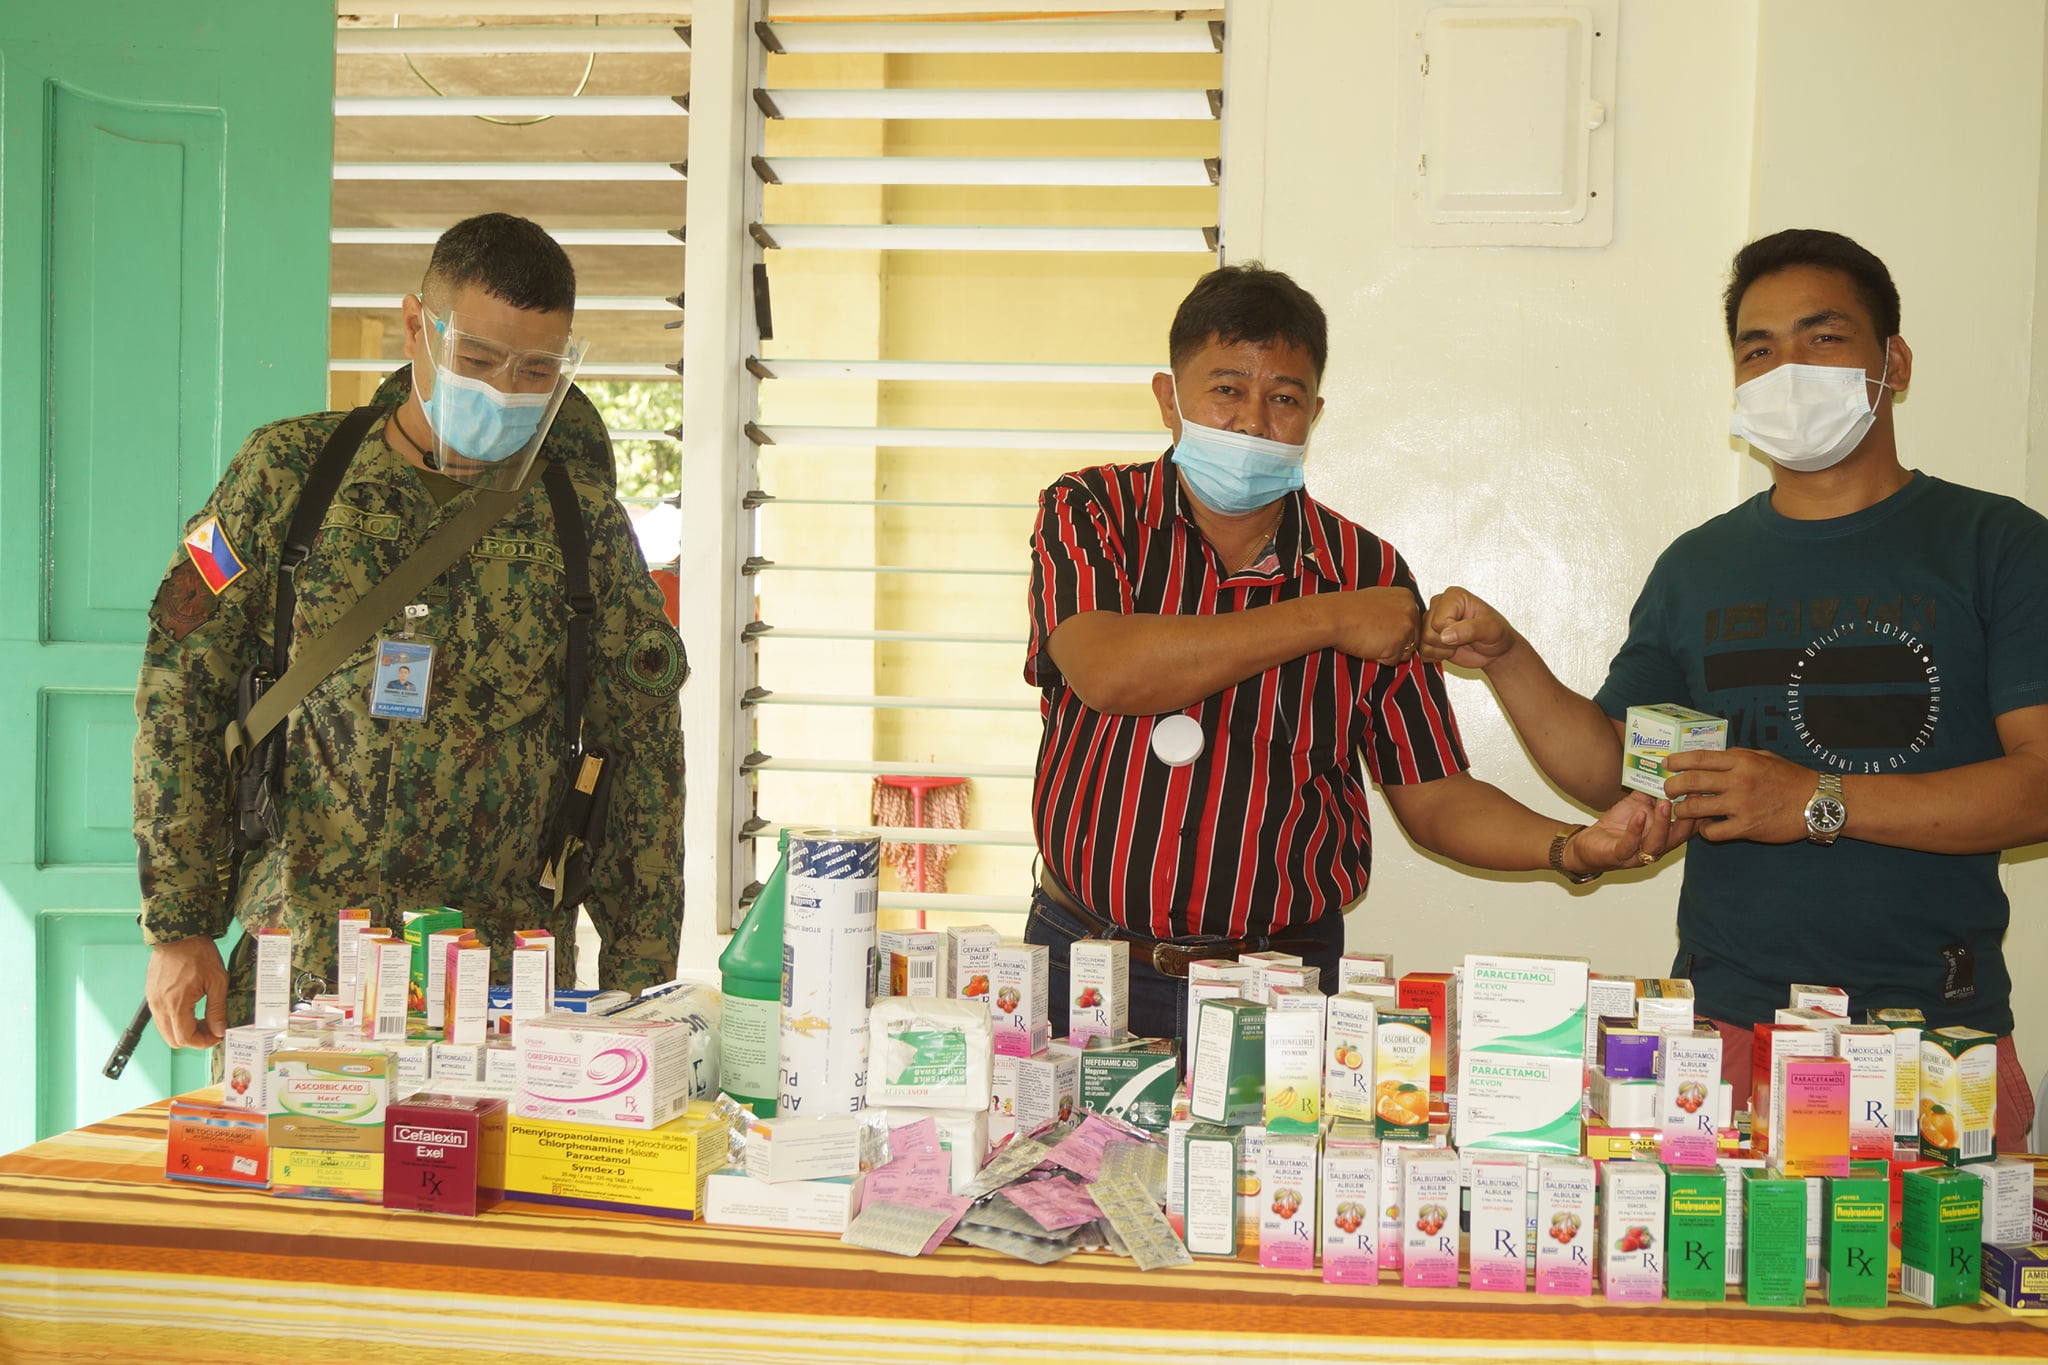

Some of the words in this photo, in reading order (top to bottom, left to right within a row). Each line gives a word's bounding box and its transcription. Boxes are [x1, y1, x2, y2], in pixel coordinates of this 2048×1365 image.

[1910, 666, 1941, 753] GUARANTEED
[1787, 672, 1853, 772] INDESTRUCTIBLE
[1632, 732, 1670, 747] Multicaps
[1864, 761, 1880, 774] BE
[1889, 753, 1907, 769] TO
[810, 844, 843, 862] Unimex
[825, 849, 858, 868] Unimex
[962, 946, 991, 954] CEFALEX
[993, 961, 1026, 970] SALBUTAMOL
[1476, 968, 1553, 983] PARACETAMOL
[1474, 982, 1508, 991] ACEVON
[1332, 1010, 1368, 1021] METRONIDAZOLE
[1384, 1036, 1410, 1044] ASCORBIC
[1412, 1036, 1426, 1044] ACID
[436, 1054, 472, 1062] METRONIDAZOLE
[527, 1052, 579, 1064] OMEPRAZOLE
[1672, 1051, 1716, 1060] SALBUTAMOL
[1085, 1058, 1120, 1067] MEFENAMIC
[1122, 1060, 1137, 1068] ACID
[914, 1068, 936, 1076] SWAB
[938, 1068, 965, 1076] GAUZE
[1471, 1065, 1548, 1079] PARACETAMOL
[294, 1082, 340, 1092] ASCORBIC
[341, 1084, 364, 1092] ACID
[1469, 1078, 1503, 1087] ACEVON
[1864, 1100, 1889, 1128] Rx
[1698, 1114, 1713, 1136] Rx
[185, 1128, 253, 1140] METOCLOPRAMIDE
[399, 1128, 462, 1144] Cefalexin
[512, 1126, 625, 1145] Phenylpropanolamine
[628, 1138, 688, 1152] Hydrochloride
[416, 1146, 444, 1158] Exel
[538, 1138, 624, 1155] Chlorphenamine
[626, 1147, 660, 1159] Maleate
[566, 1151, 631, 1165] Paracetamol
[1268, 1159, 1310, 1168] SALBUTAMOL
[571, 1163, 625, 1176] Symdex-D
[1329, 1173, 1372, 1181] SALBUTAMOL
[1476, 1179, 1520, 1188] SALBUTAMOL
[1546, 1182, 1588, 1191] SALBUTAMOL
[1294, 1220, 1309, 1241] Rx
[1358, 1234, 1374, 1255] Rx
[1439, 1236, 1454, 1257] Rx
[1494, 1229, 1518, 1258] Rx
[1572, 1245, 1588, 1266] Rx
[1684, 1240, 1713, 1270] Rx
[1847, 1247, 1876, 1276] Rx
[1643, 1252, 1658, 1273] Rx
